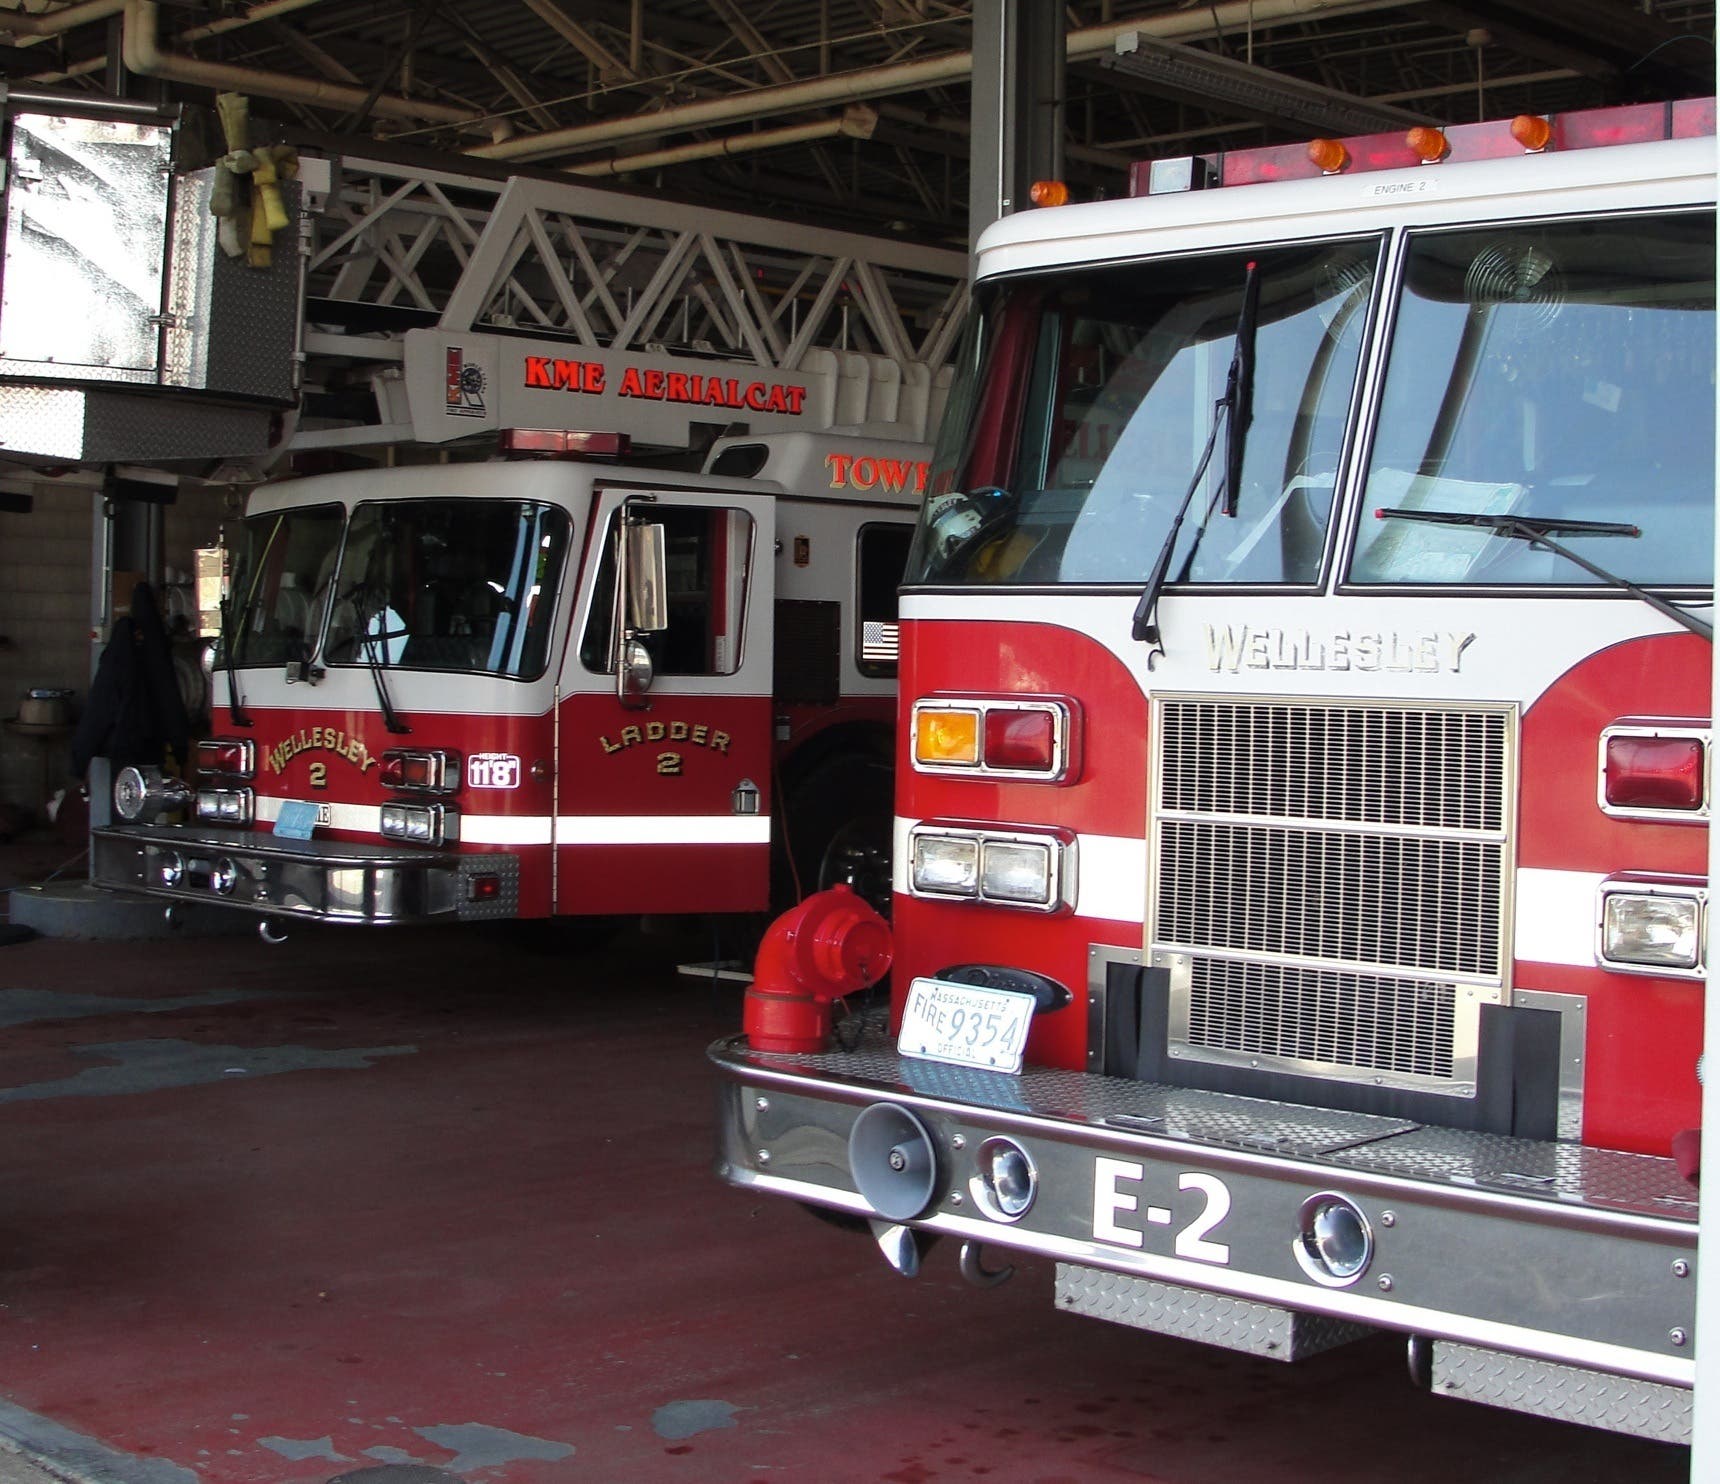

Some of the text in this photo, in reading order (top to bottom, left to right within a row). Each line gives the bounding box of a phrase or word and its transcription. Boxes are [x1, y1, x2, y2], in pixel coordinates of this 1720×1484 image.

[1374, 181, 1426, 195] ENGINE 2
[525, 356, 606, 394] KME
[618, 368, 807, 415] AERIALCAT
[1204, 623, 1477, 674] WELLESLEY
[269, 727, 377, 775] WELLESLEY
[600, 721, 730, 754] LADDER
[309, 762, 327, 788] 2
[657, 752, 682, 775] 2
[929, 991, 1009, 1013] MASSACHUSETTS
[914, 993, 1019, 1056] FIRE 9354
[937, 1042, 977, 1059] OFFICIAL
[1093, 1156, 1232, 1265] E-2
